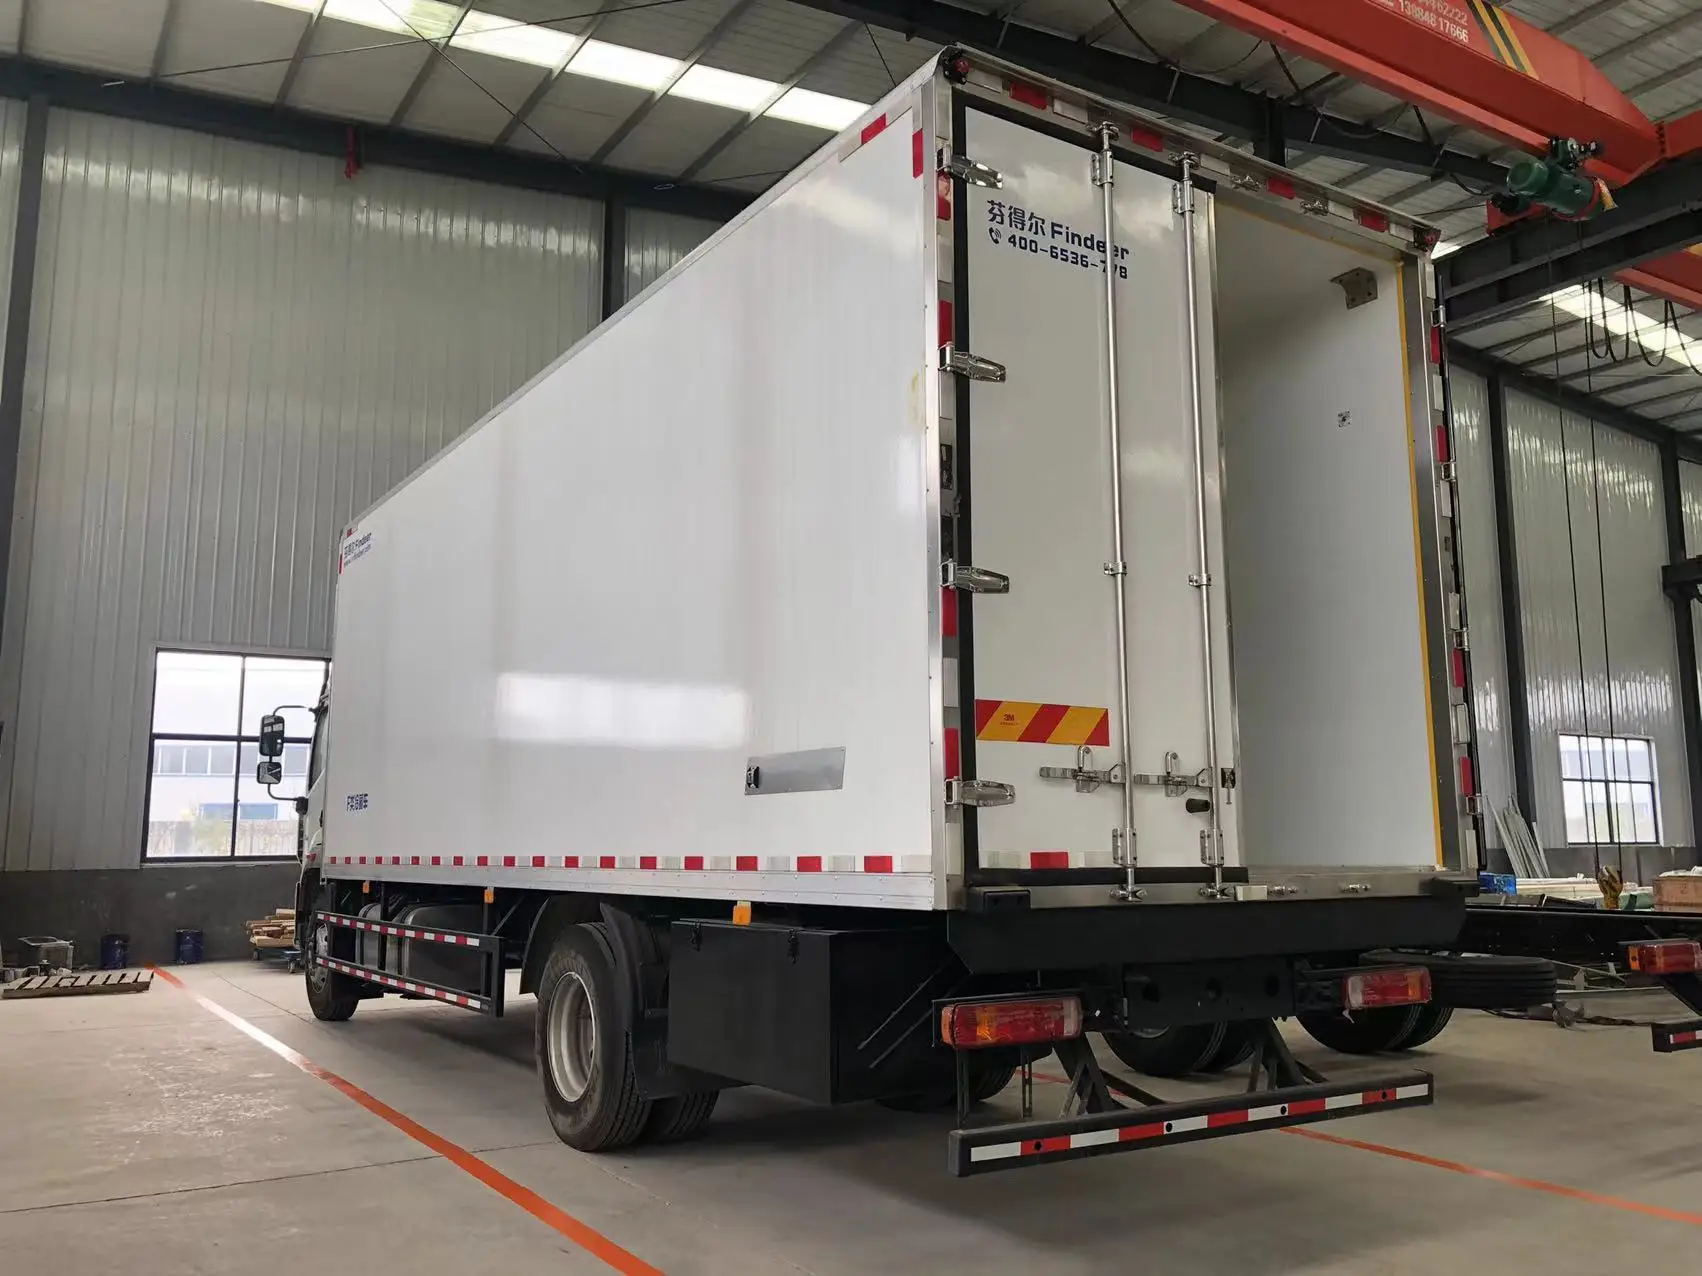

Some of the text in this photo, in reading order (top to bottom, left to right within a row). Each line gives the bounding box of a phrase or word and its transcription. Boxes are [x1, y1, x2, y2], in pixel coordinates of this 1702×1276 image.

[987, 200, 1046, 236] 芬得尔
[1003, 713, 1015, 721] 3M
